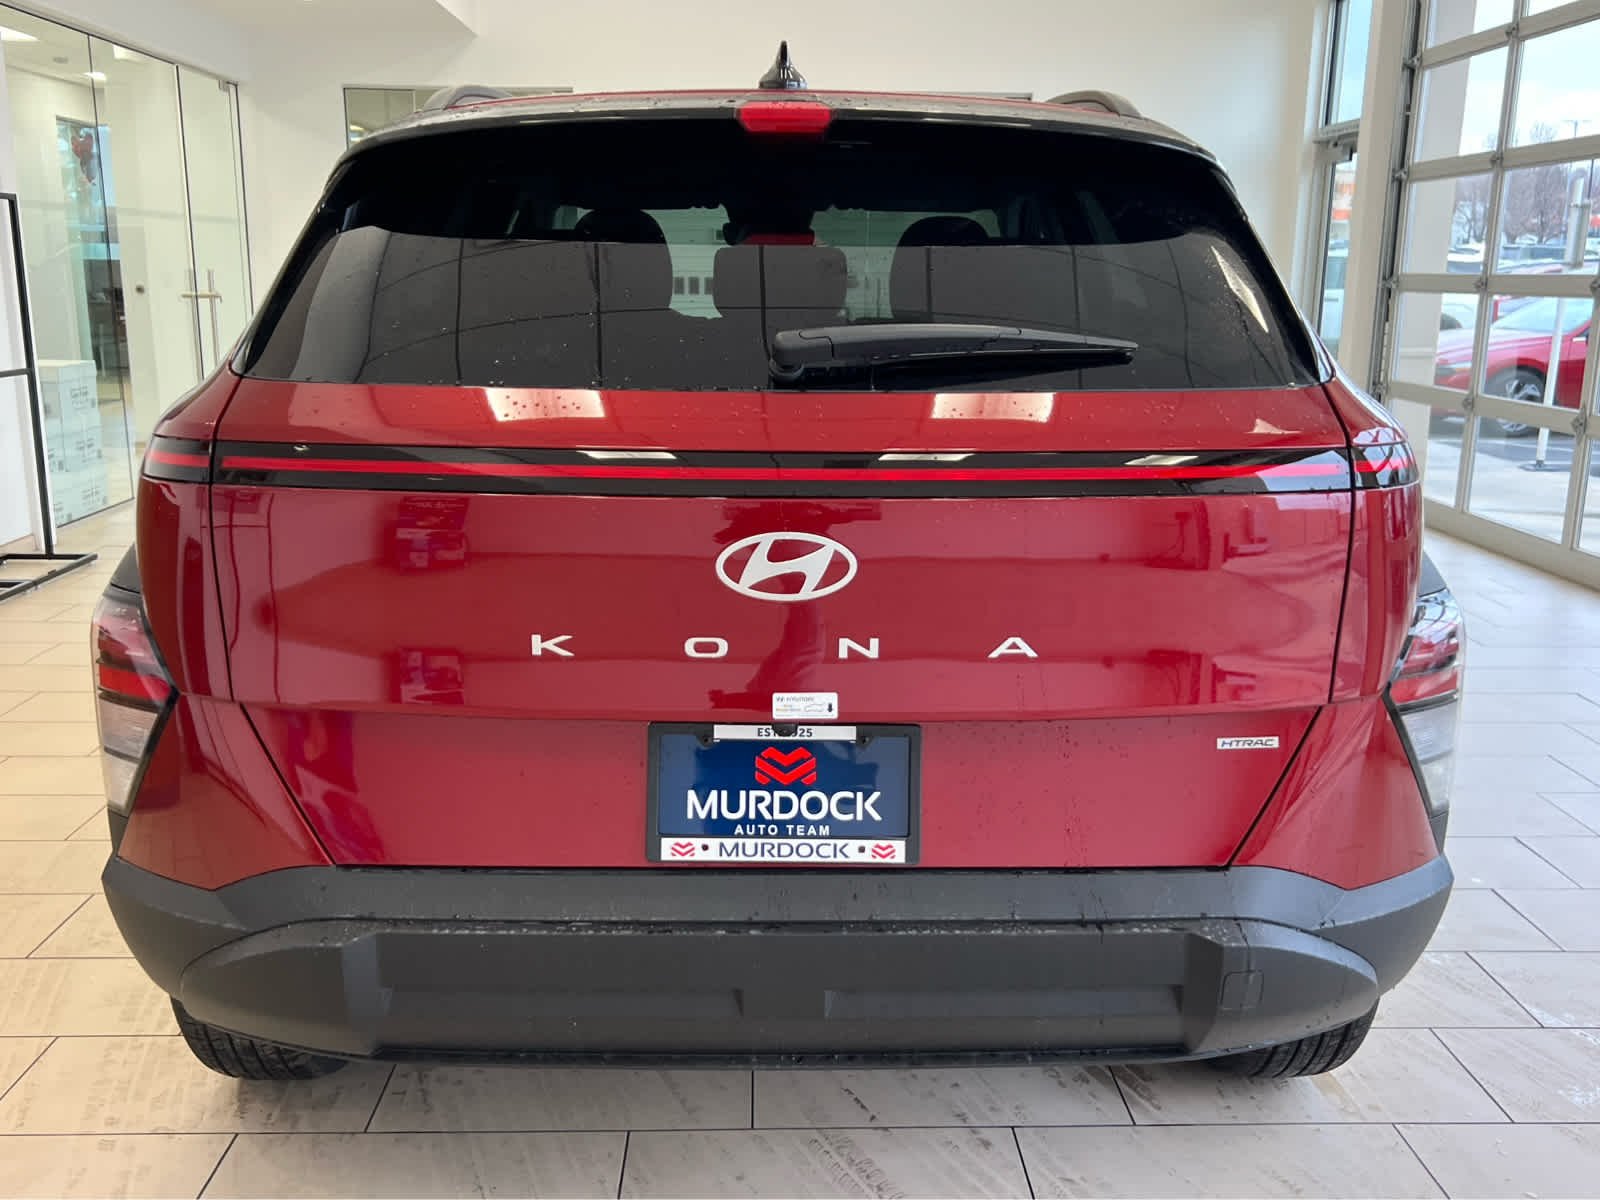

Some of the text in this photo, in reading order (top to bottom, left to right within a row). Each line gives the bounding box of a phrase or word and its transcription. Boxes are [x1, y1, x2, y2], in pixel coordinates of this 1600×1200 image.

[531, 634, 1039, 659] KONA
[1221, 738, 1275, 748] HTRAC
[686, 789, 882, 821] MURDOCK
[734, 824, 830, 836] AUTO TEAM
[719, 841, 850, 859] MURDOCK
